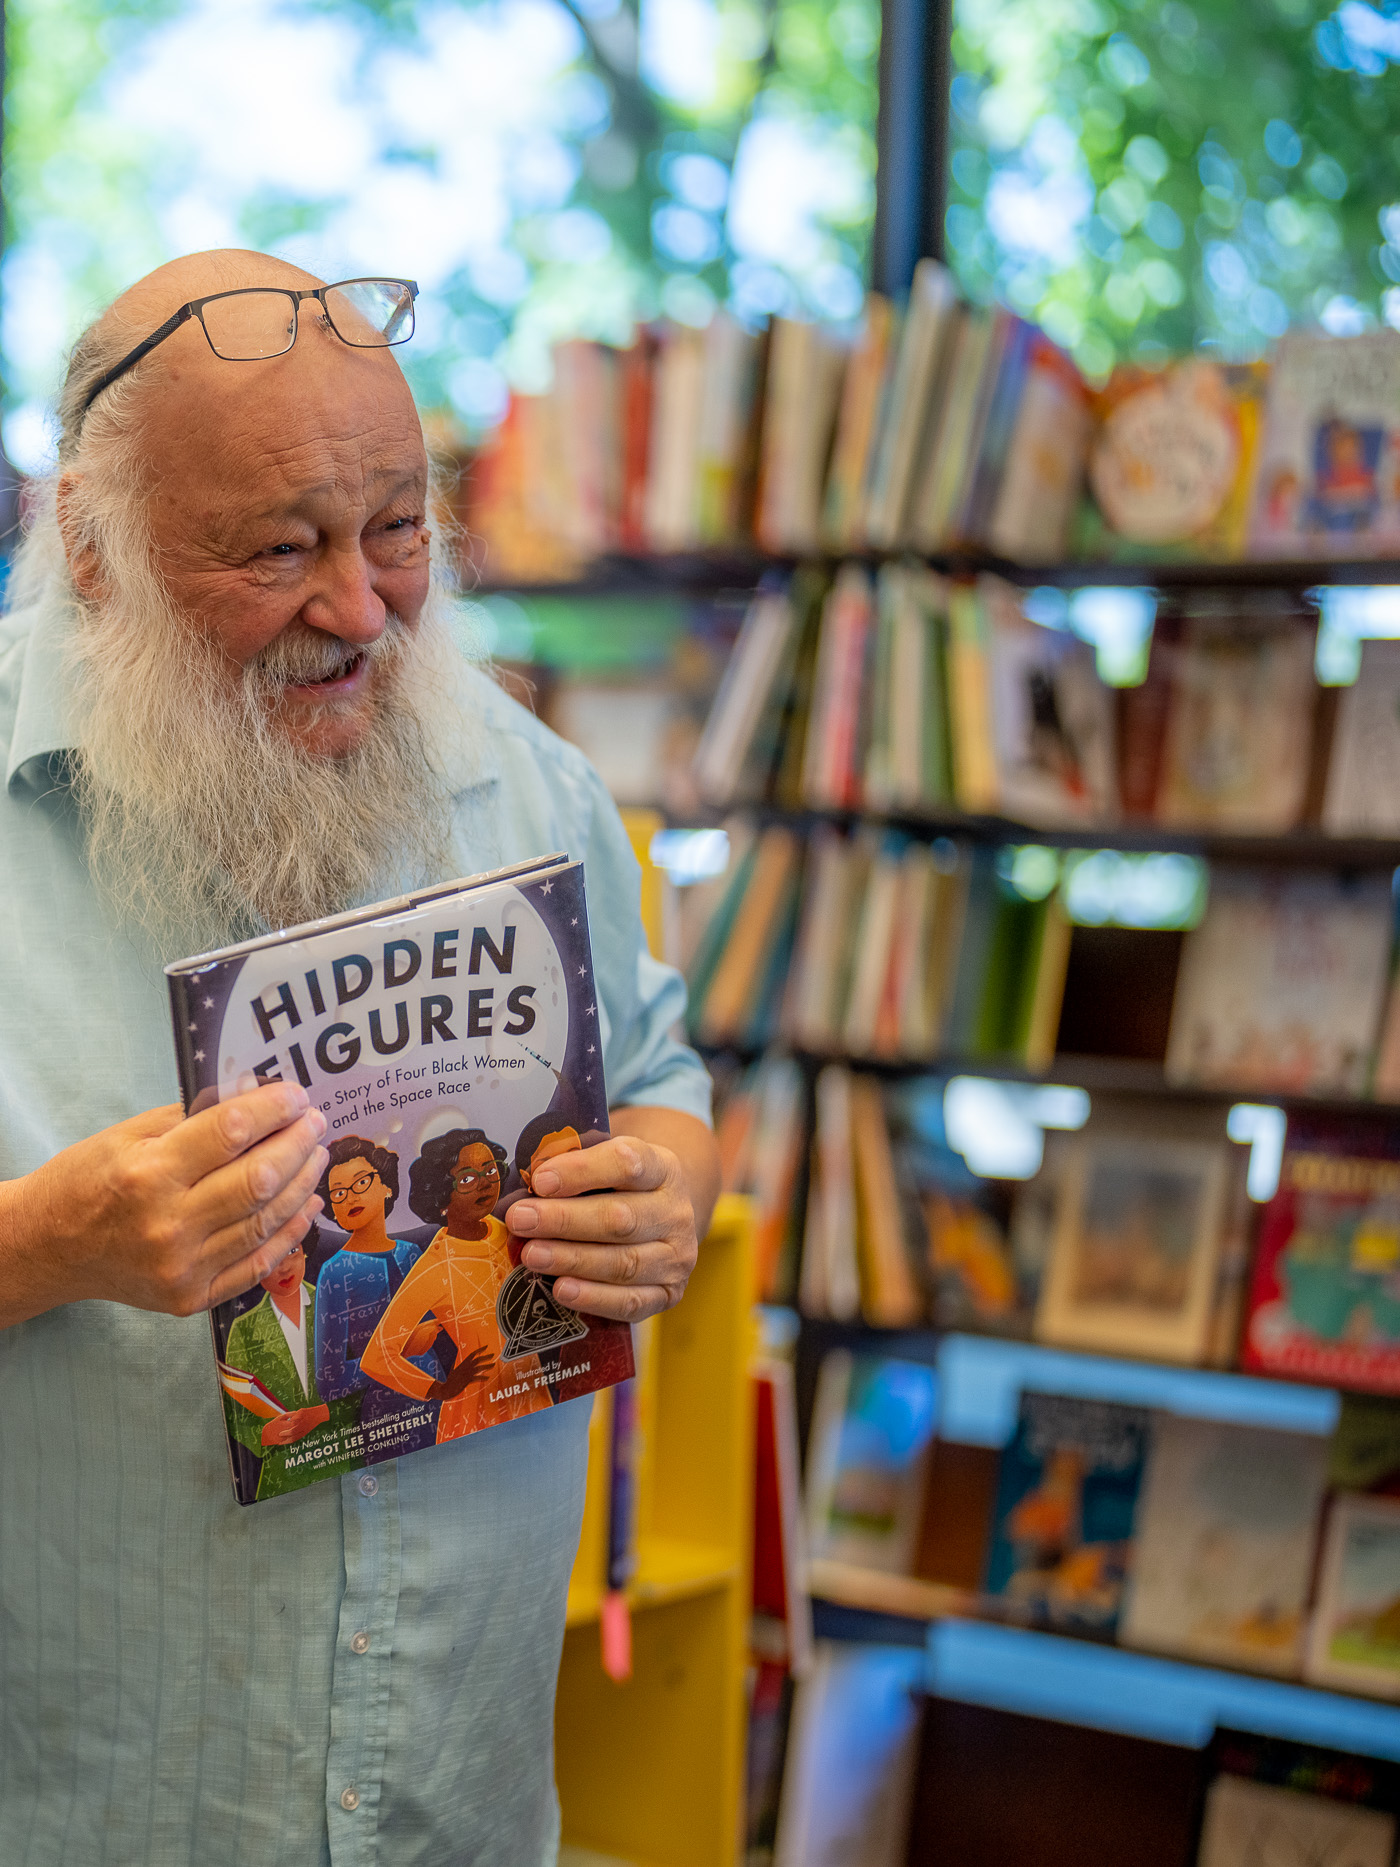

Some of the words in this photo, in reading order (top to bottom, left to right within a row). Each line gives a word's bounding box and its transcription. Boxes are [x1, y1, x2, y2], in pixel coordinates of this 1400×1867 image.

[250, 925, 517, 1044] HIDDEN
[252, 985, 537, 1089] FIGURES
[332, 1104, 360, 1129] and
[363, 1098, 386, 1116] the
[390, 1088, 433, 1109] Space
[437, 1081, 471, 1096] Race
[334, 1082, 372, 1105] Story
[376, 1070, 392, 1089] of
[395, 1067, 427, 1084] Four
[432, 1055, 469, 1075] Black
[473, 1055, 526, 1069] Women
[489, 1382, 530, 1403] LAURA
[534, 1361, 591, 1388] FREEMAN
[516, 1362, 550, 1381] illustrated
[552, 1360, 562, 1371] by
[285, 1442, 340, 1469] MARGOT
[344, 1434, 365, 1450] LEE
[369, 1412, 434, 1442] SHETTERLY
[290, 1445, 300, 1455] by
[302, 1438, 320, 1450] New
[322, 1431, 338, 1442] York
[340, 1424, 361, 1437] Times
[361, 1411, 400, 1430] bestselling
[401, 1404, 426, 1417] author
[312, 1460, 327, 1470] with
[327, 1447, 365, 1465] WINIFRED
[367, 1433, 410, 1453] CONKLING
